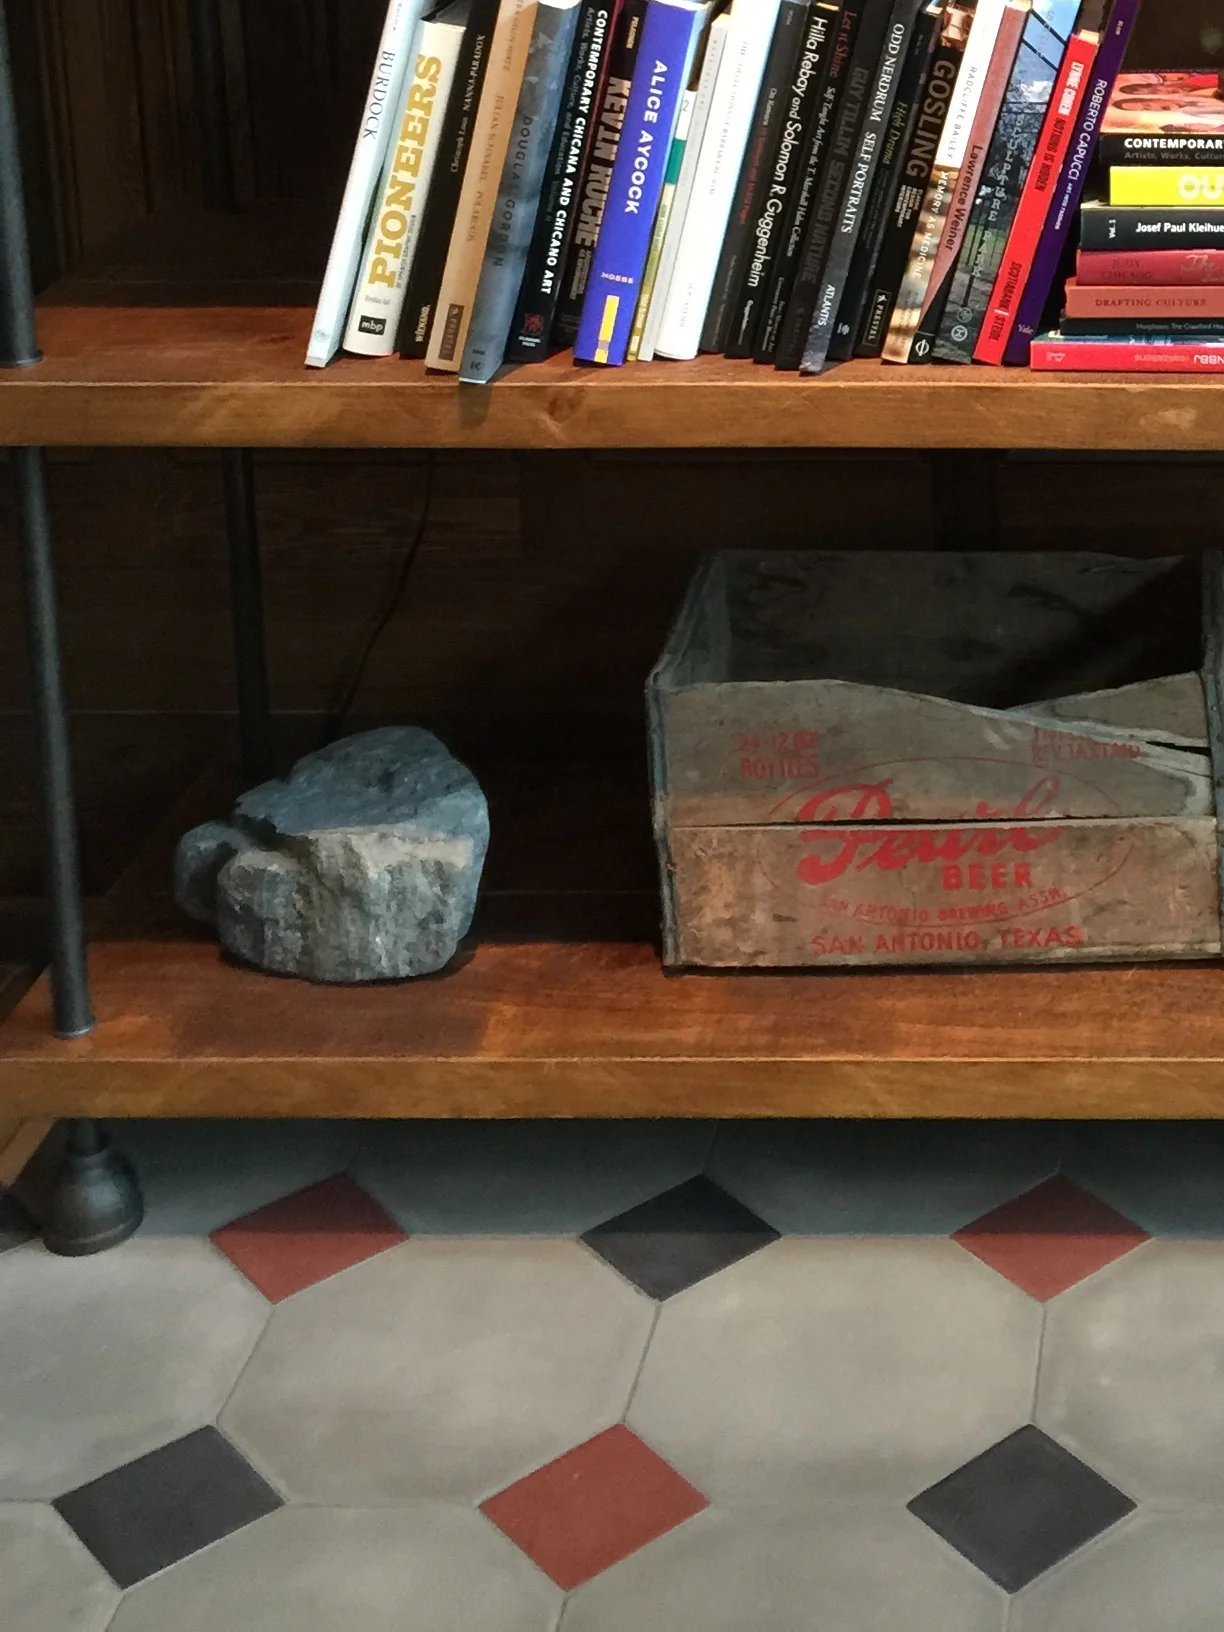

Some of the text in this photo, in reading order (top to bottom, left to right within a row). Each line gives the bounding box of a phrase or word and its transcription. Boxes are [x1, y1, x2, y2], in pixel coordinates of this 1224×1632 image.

[792, 51, 820, 98] Rebay
[806, 16, 828, 51] Hilla
[362, 50, 396, 141] BURDOCK
[592, 76, 632, 161] KEVIN
[624, 59, 668, 215] ALICE AYCOCK
[788, 97, 802, 120] and
[906, 59, 957, 178] GOSLING
[1067, 78, 1108, 181] ROBERTO CAPUCCI
[368, 53, 442, 289] PIONEERS
[492, 115, 533, 267] DOUGLAS GORDON
[541, 9, 608, 295] CONTEMPORARY CHICANA AND CHICANO ART
[768, 184, 787, 198] R.
[773, 120, 803, 182] Solomon
[817, 22, 906, 326] ODD NERDRUM SELF PORTRAITS ATLANTIS
[574, 163, 613, 248] ROCHE
[913, 170, 950, 280] MEMORY AS MEDICINE
[945, 144, 984, 251] Lawrence Weiner
[1135, 222, 1161, 233] Josef
[1163, 222, 1186, 233] Paul
[747, 198, 783, 288] Guggenheim
[361, 320, 384, 333] mbp
[1095, 298, 1151, 307] DRAFTING
[795, 776, 1067, 886] Pearl
[941, 862, 1033, 891] BEER
[809, 924, 1085, 956] SAN TEXAS
